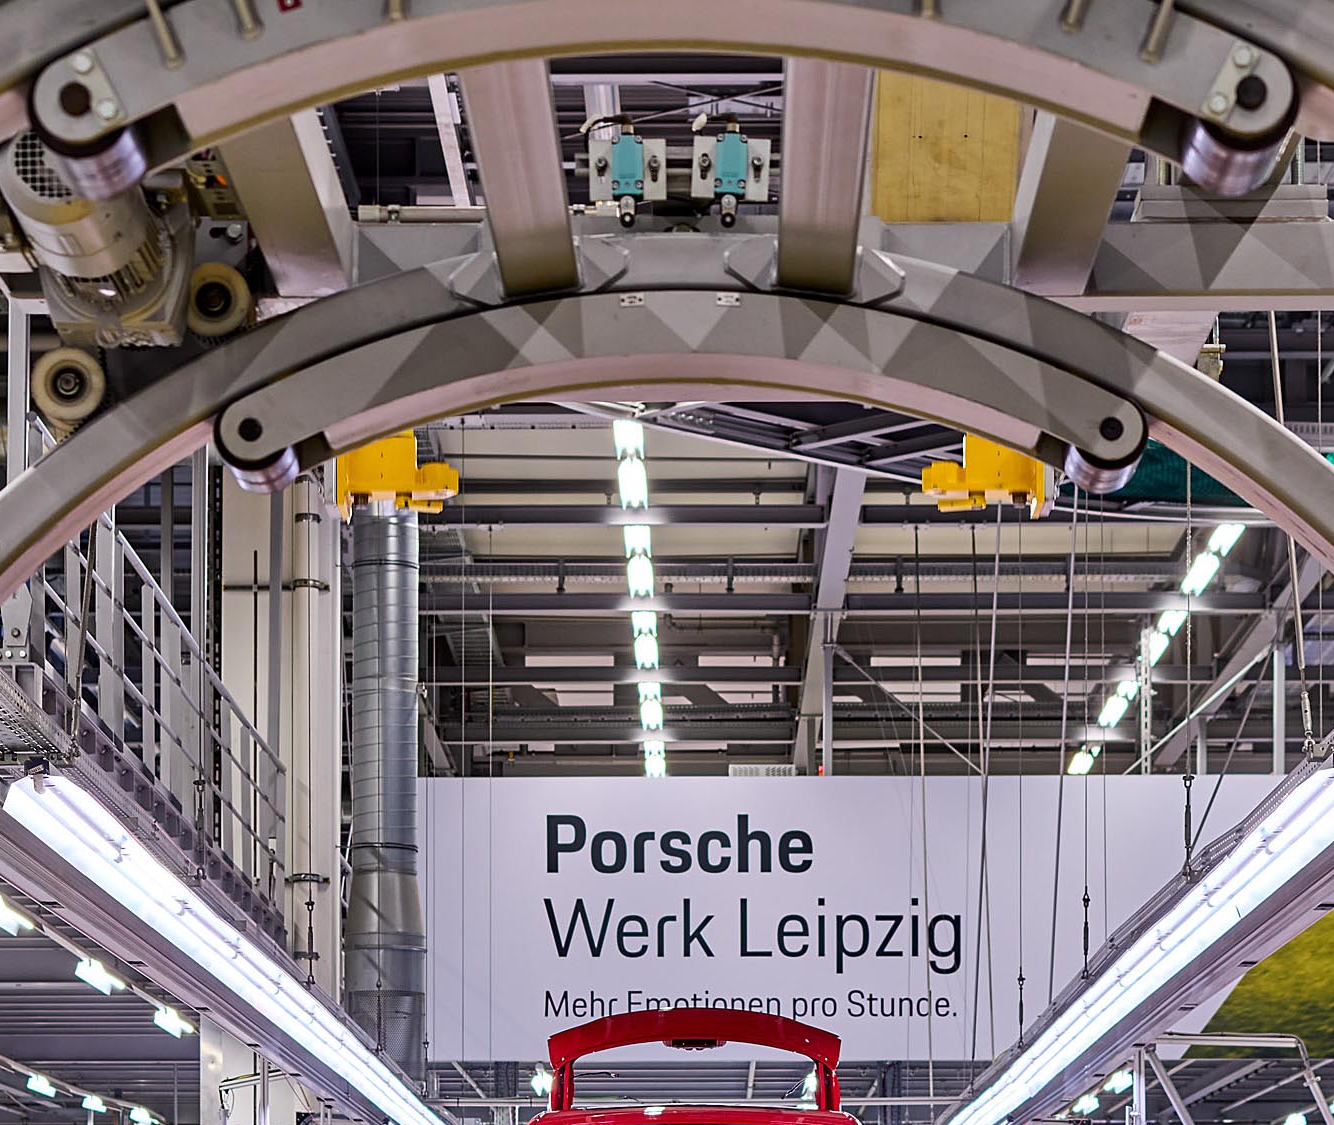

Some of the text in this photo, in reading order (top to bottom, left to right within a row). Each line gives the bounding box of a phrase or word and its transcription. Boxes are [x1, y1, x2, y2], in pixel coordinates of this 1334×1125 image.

[546, 814, 814, 874] Porsche
[543, 897, 962, 974] Werk Leipzig
[544, 990, 958, 1021] Mehr Emotionen pro Stunde.
